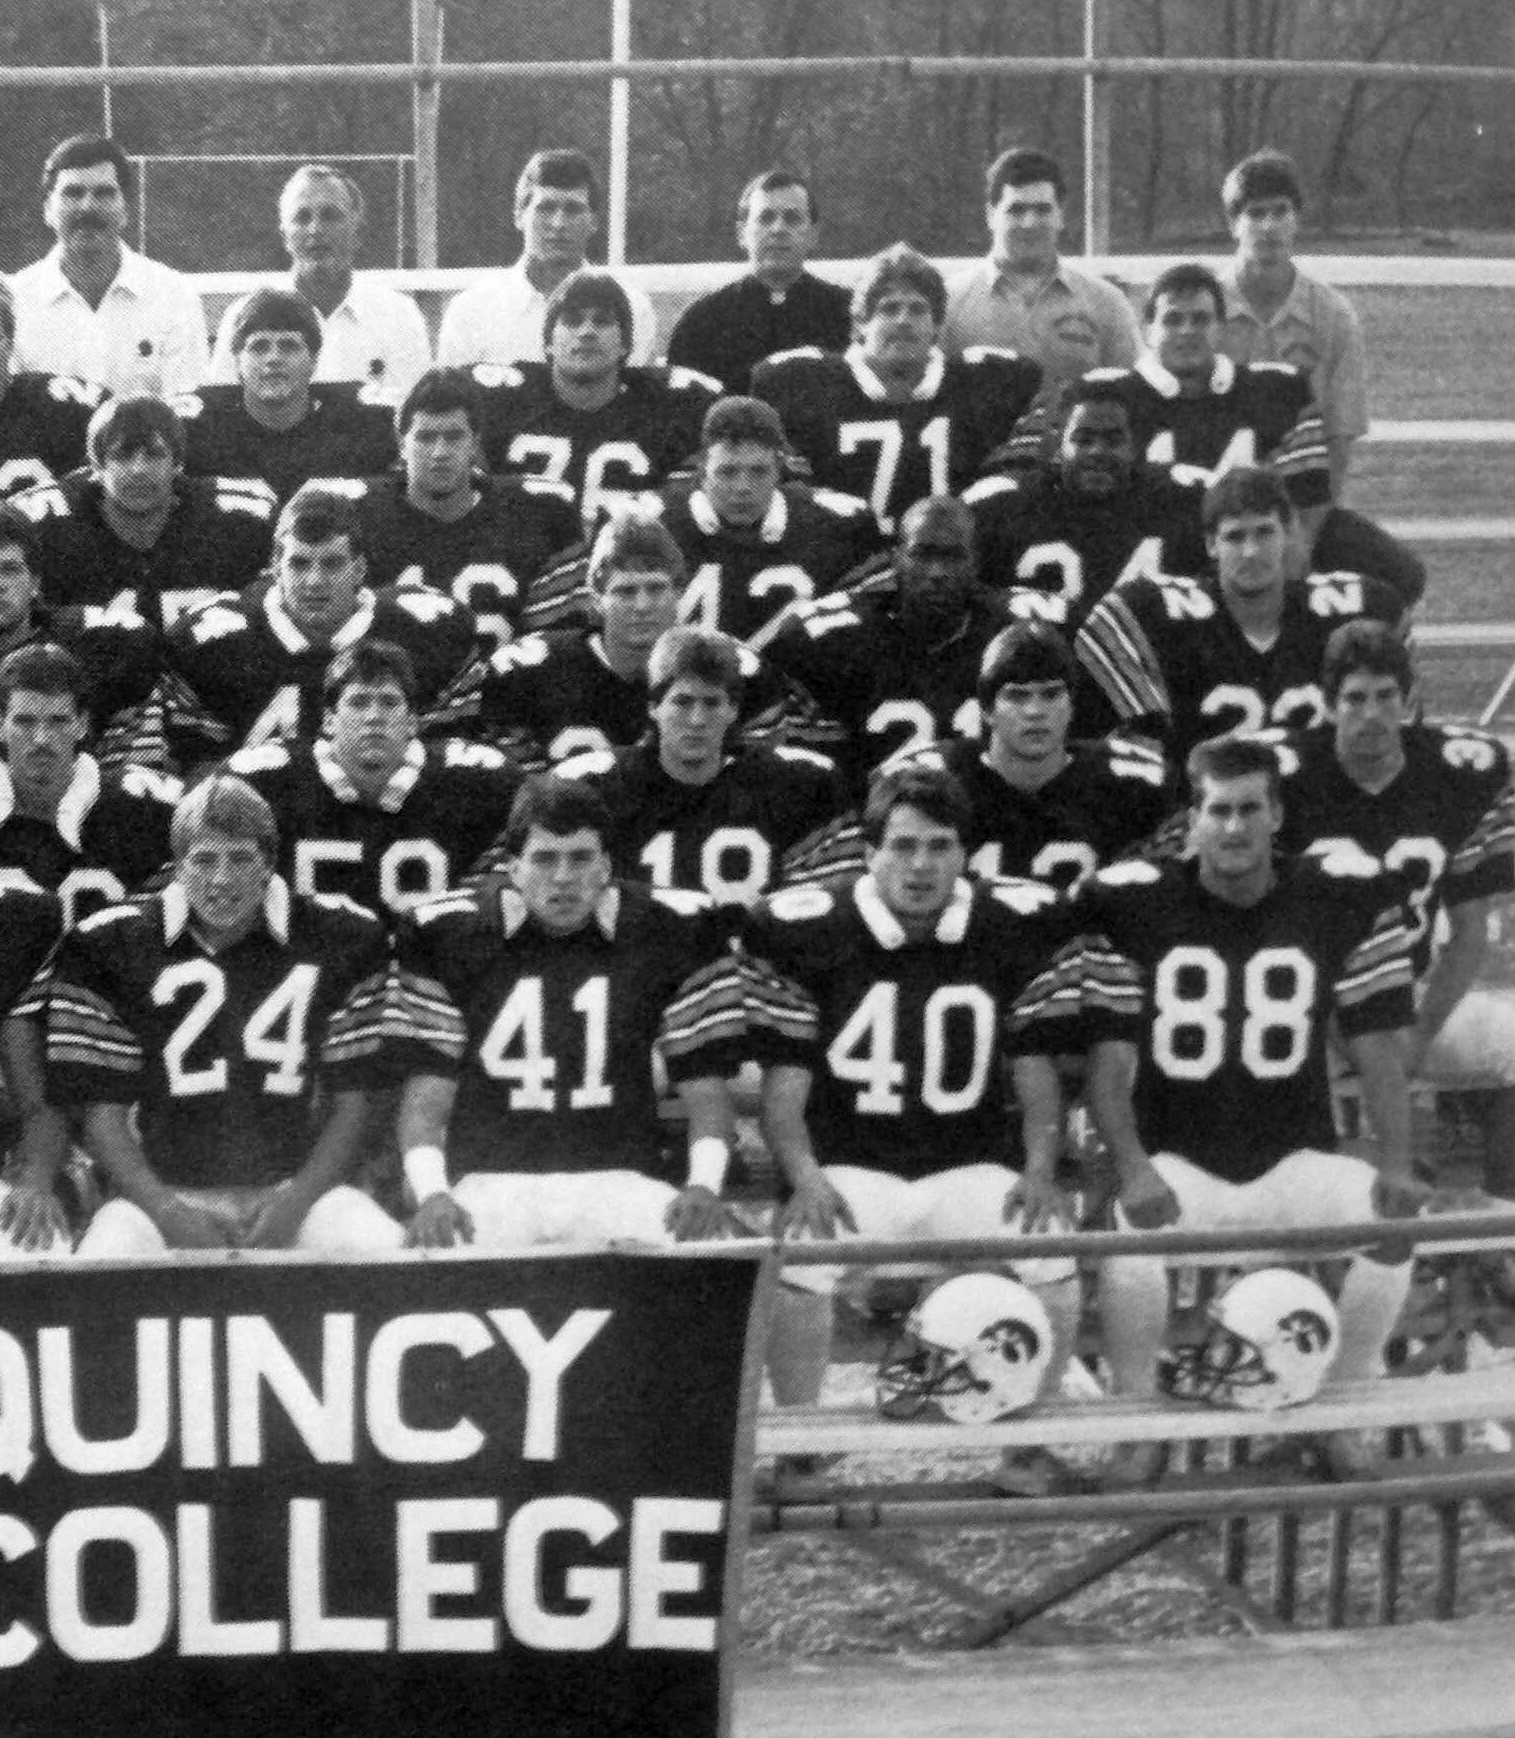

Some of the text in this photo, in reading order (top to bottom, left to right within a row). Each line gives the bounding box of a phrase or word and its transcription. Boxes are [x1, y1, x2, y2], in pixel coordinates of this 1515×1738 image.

[839, 416, 950, 534] 71
[152, 958, 320, 1095] 24
[480, 977, 613, 1110] 41
[828, 982, 995, 1113] 40
[1153, 946, 1316, 1079] 88
